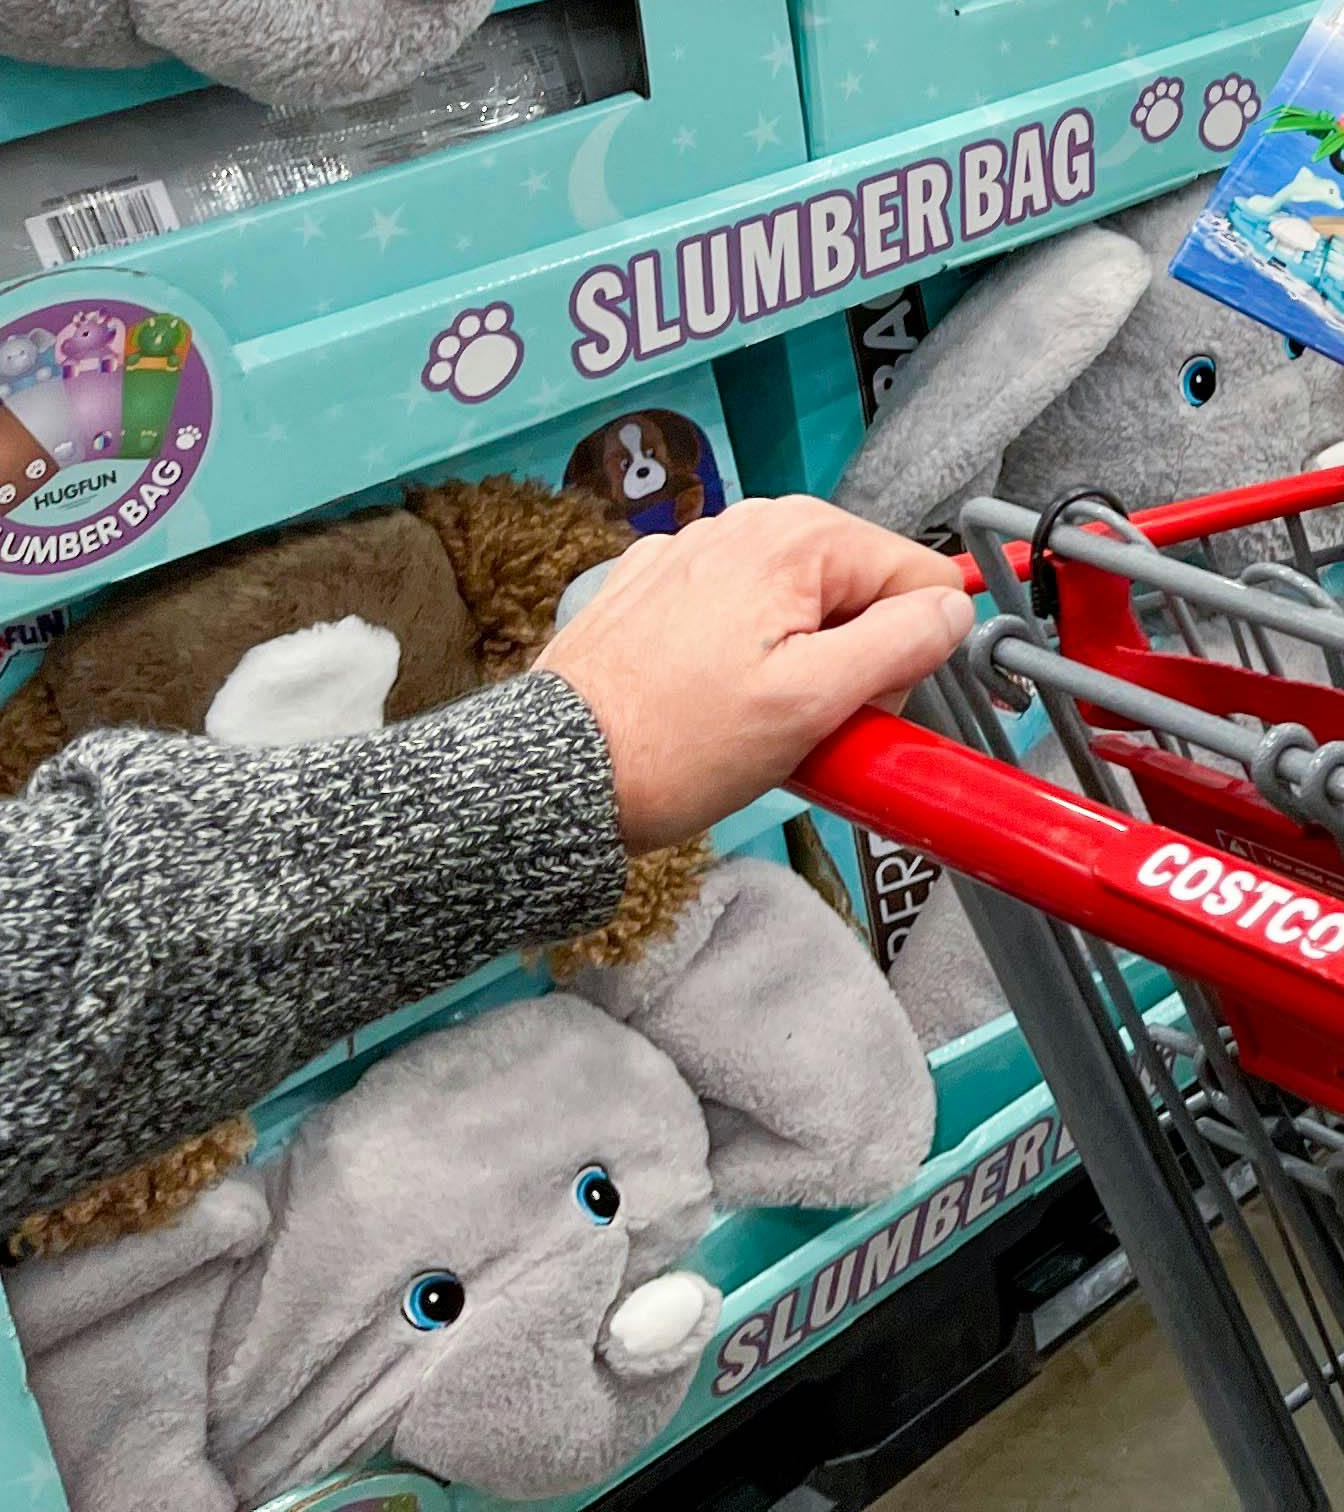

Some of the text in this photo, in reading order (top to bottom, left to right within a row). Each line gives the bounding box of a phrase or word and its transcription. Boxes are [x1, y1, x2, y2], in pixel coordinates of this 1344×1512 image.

[572, 161, 952, 375] SLUMBER
[963, 110, 1093, 238] BAG
[0, 459, 182, 566] UMBER BAG
[34, 470, 118, 510] HUGFUN
[713, 1119, 1052, 1396] SLUMBER
